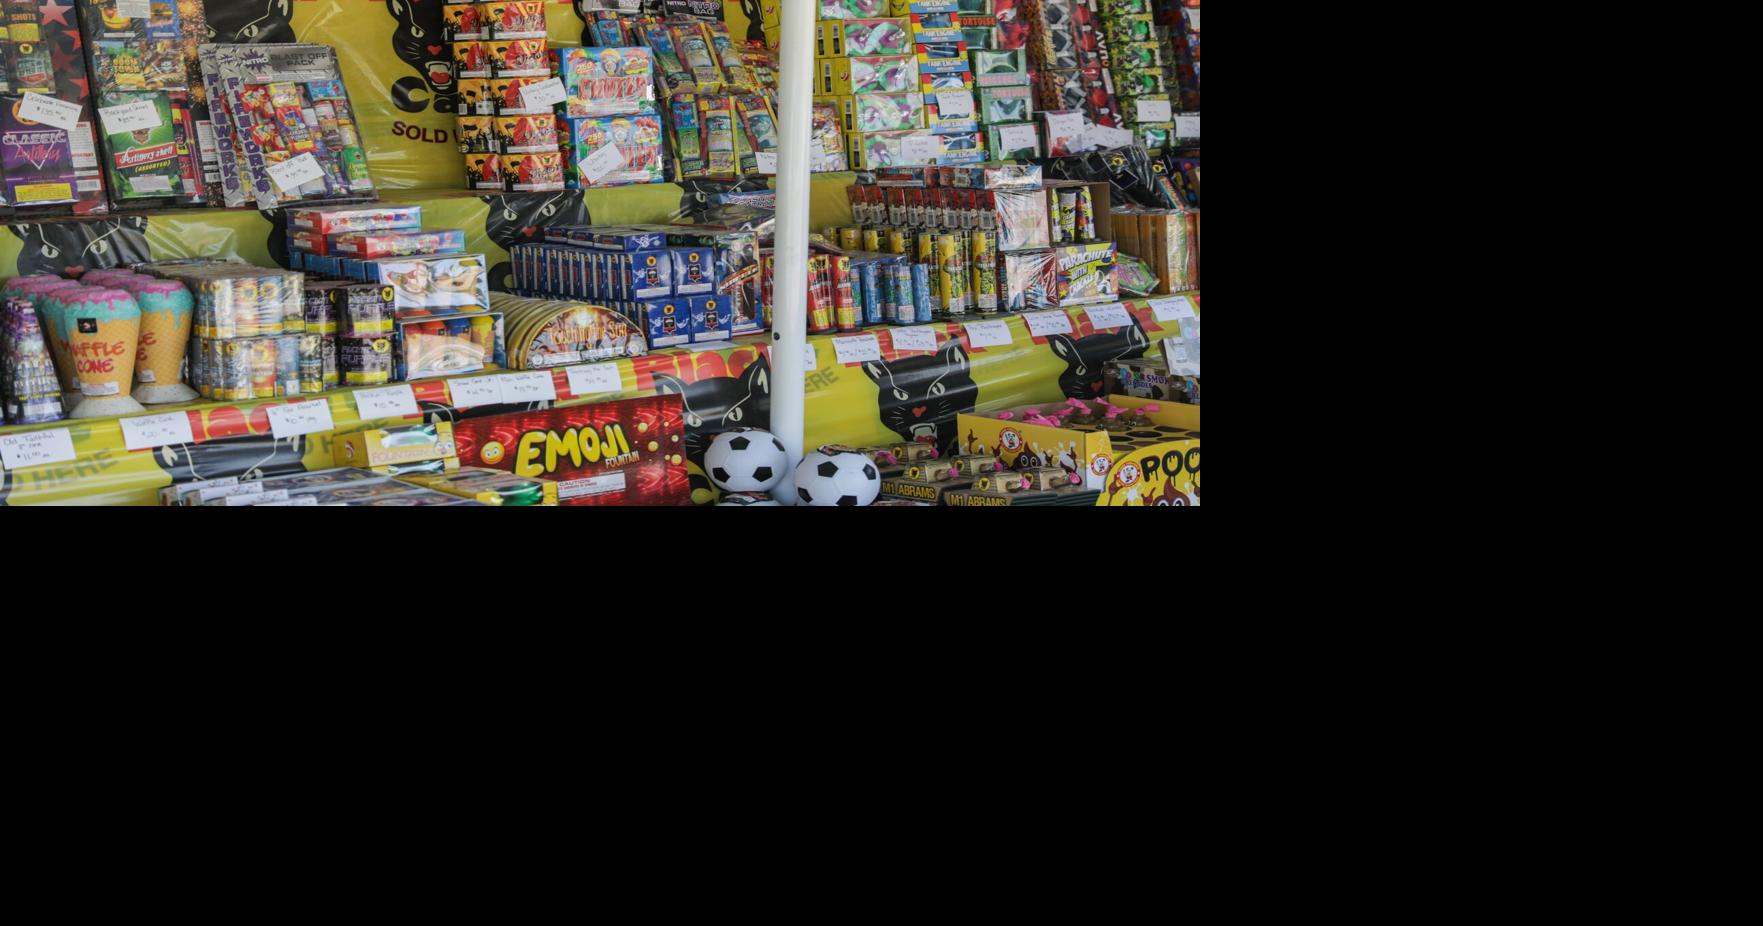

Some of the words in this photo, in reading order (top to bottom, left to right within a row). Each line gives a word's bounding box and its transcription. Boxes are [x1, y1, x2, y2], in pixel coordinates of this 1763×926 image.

[242, 57, 269, 67] NITRO
[285, 58, 316, 66] PACK
[307, 51, 329, 60] OFF
[3, 131, 67, 146] CLASSIC
[227, 76, 272, 195] FIREWORKS
[391, 120, 449, 144] SOLD
[1058, 248, 1115, 271] PARACHUTE
[1071, 264, 1089, 282] WITH
[72, 340, 126, 357] WAFFLE
[77, 358, 115, 374] CONE
[514, 423, 632, 480] EMOJI
[604, 450, 641, 470] FOUNTAIN
[882, 481, 896, 493] M1
[898, 481, 937, 499] ABRAMS
[950, 494, 964, 506] M1
[968, 496, 1009, 506] ABRAMS
